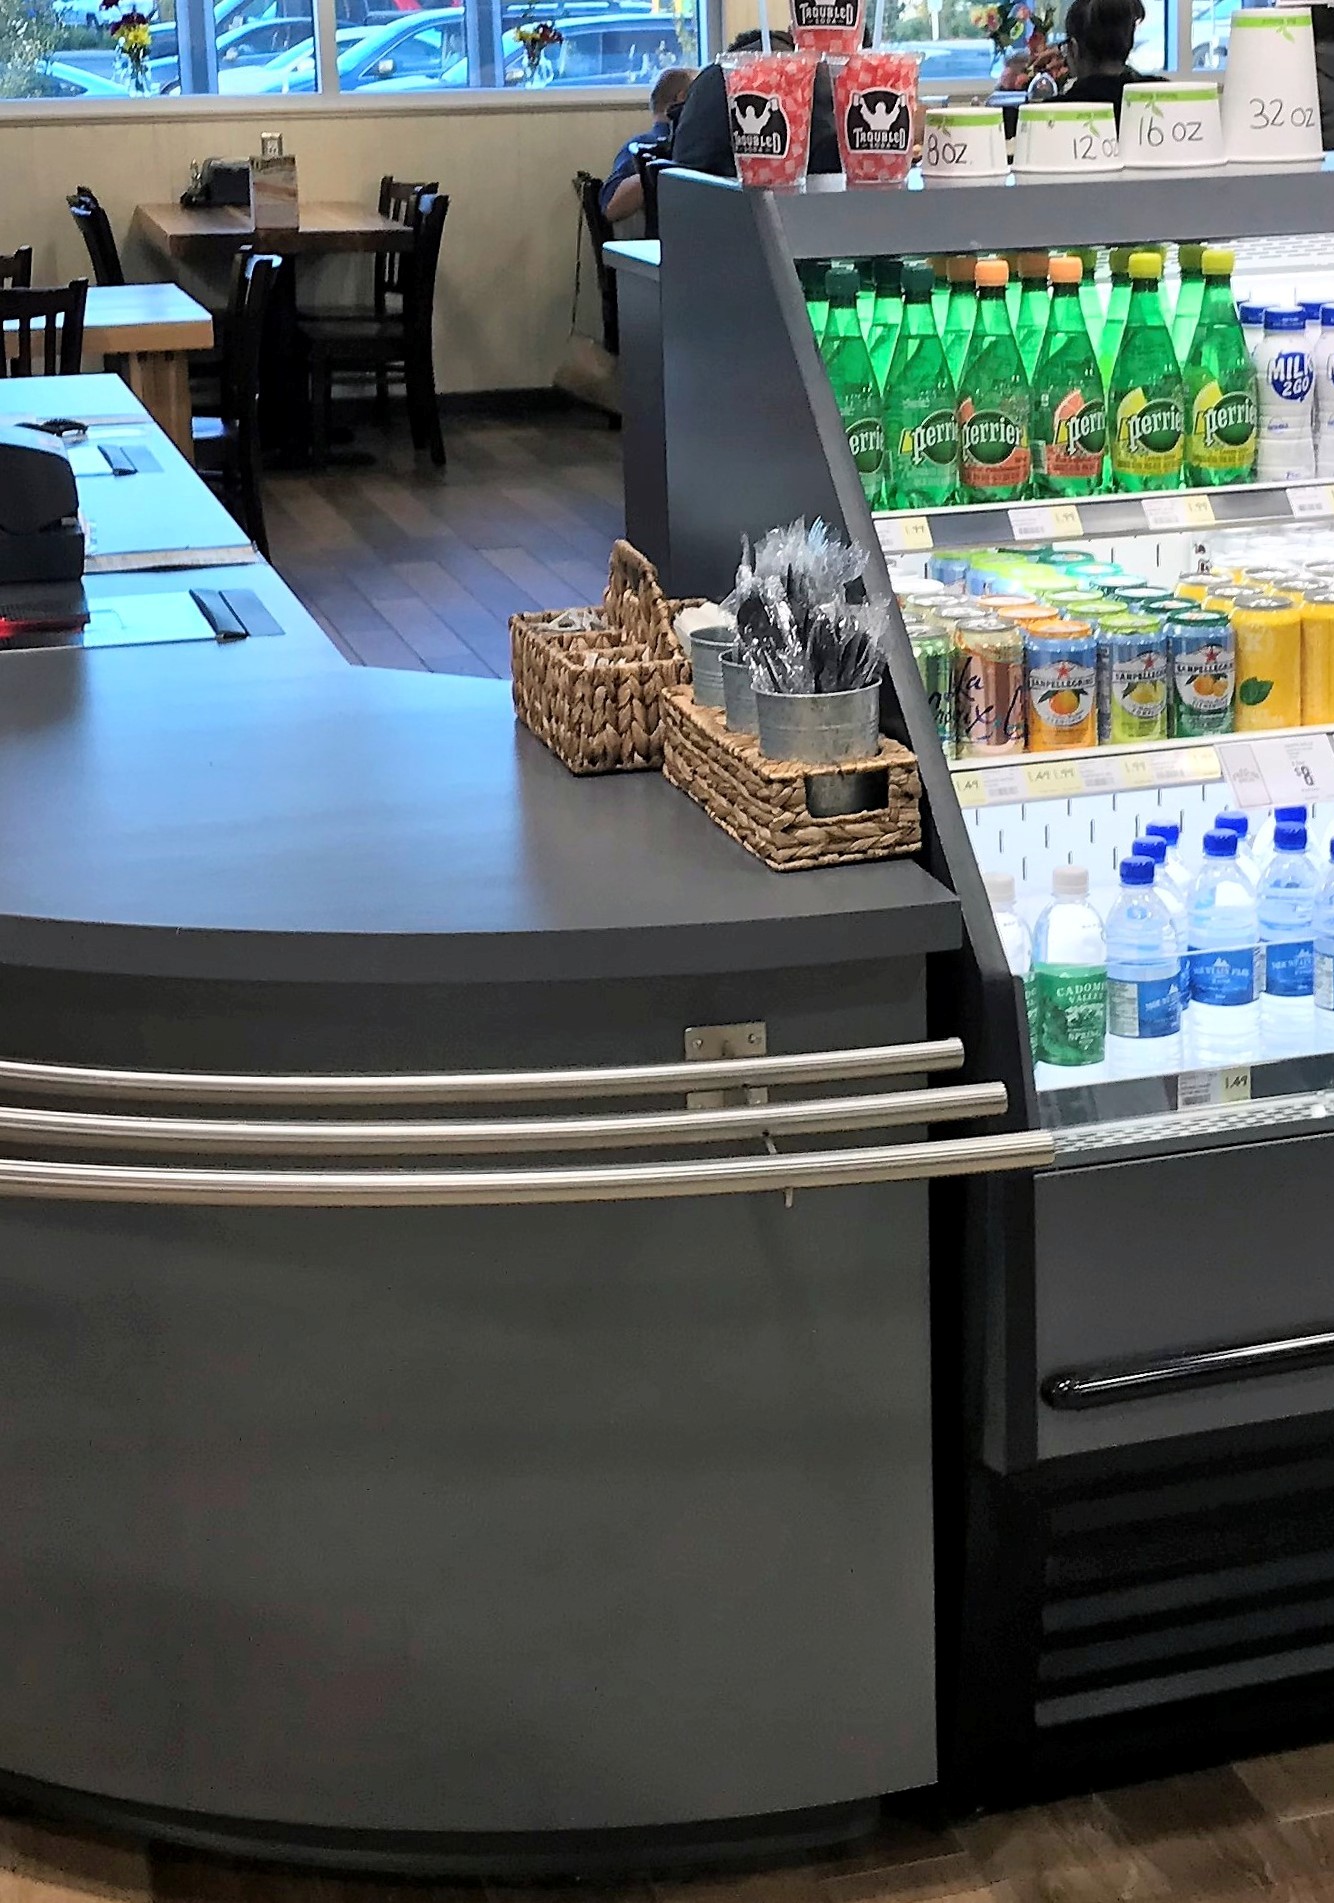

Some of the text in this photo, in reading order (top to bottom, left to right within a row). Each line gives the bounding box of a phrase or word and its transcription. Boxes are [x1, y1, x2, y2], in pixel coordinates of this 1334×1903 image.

[799, 3, 853, 25] TROUBLED
[1249, 97, 1286, 130] 32
[853, 127, 906, 149] TROUBLED
[1138, 117, 1165, 147] 16
[1073, 135, 1097, 161] 12
[1267, 352, 1314, 382] MILK
[1281, 375, 1310, 397] 2GO
